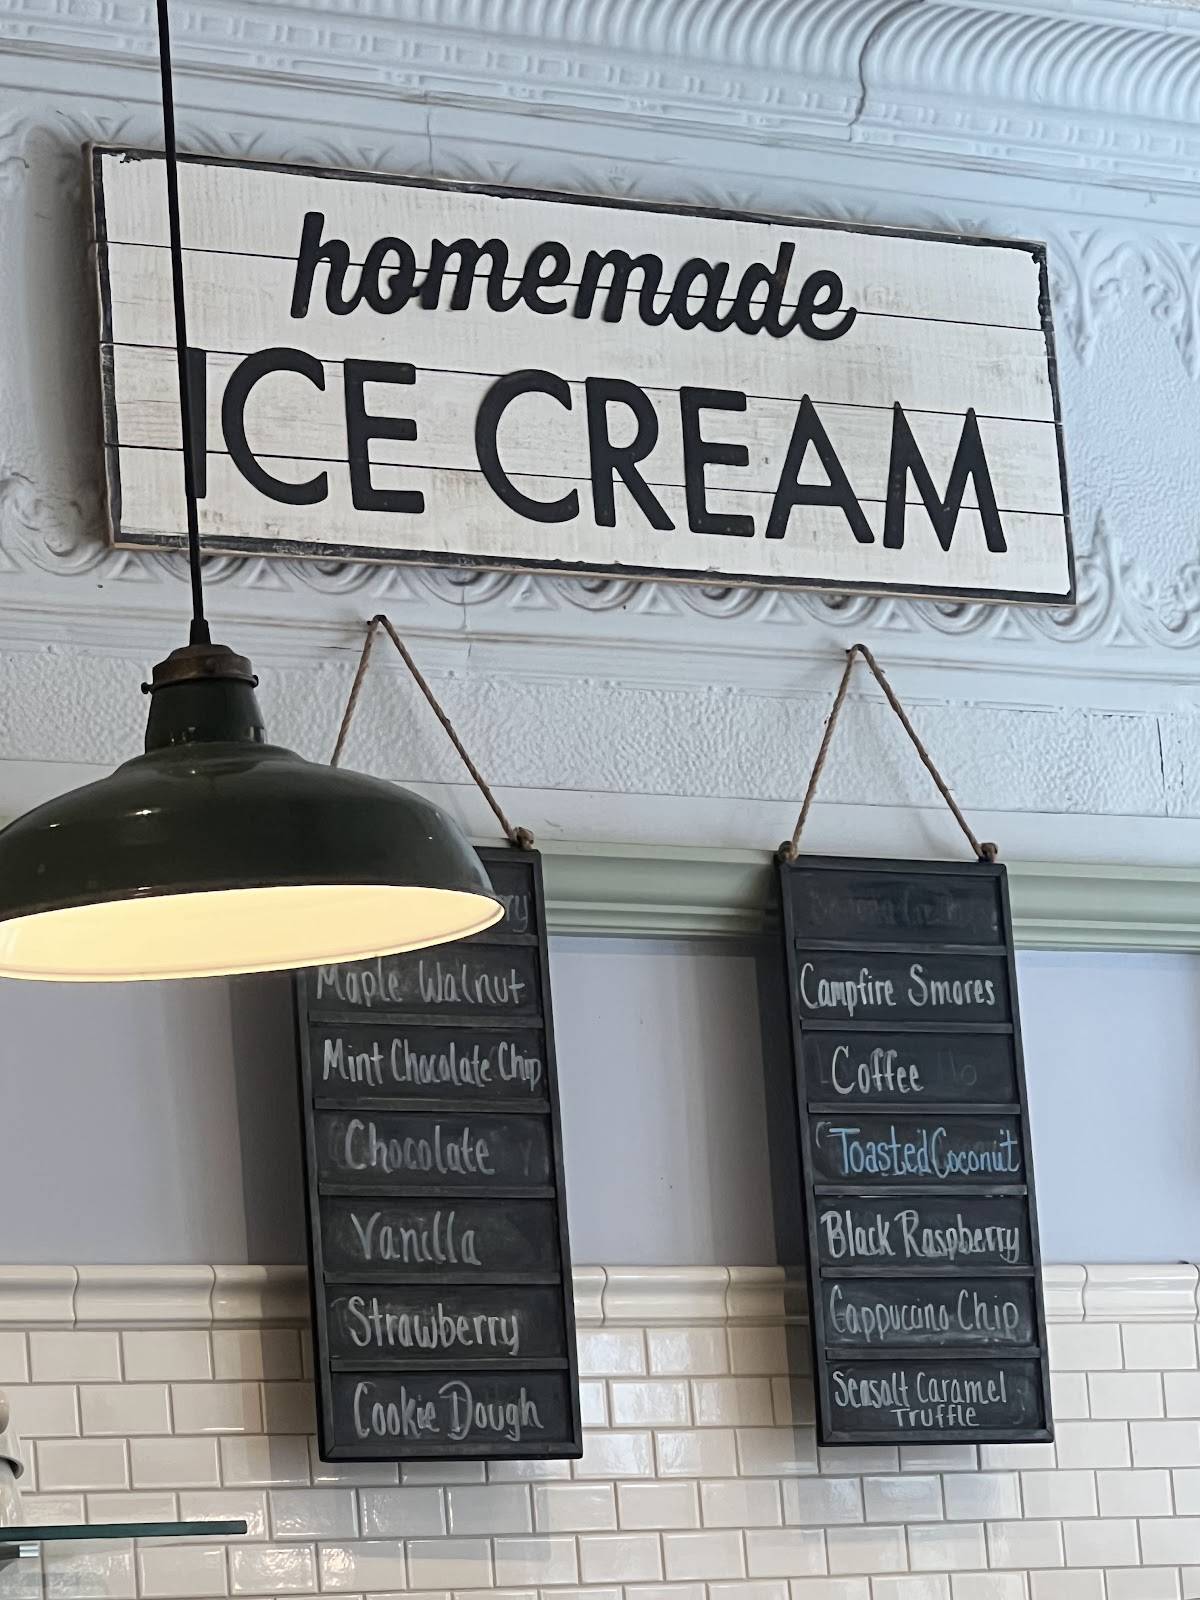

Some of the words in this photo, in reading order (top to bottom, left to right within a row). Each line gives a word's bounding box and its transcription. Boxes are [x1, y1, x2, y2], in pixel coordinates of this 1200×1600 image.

[289, 211, 857, 340] homemade
[180, 346, 425, 514] ICE
[475, 367, 1008, 554] CREAM
[317, 958, 402, 1007] Maple
[419, 960, 525, 1004] Walnut
[800, 963, 897, 1016] Campfire
[908, 963, 996, 1007] Smores
[323, 1038, 384, 1086] Mint
[391, 1038, 492, 1087] Chocolate
[499, 1041, 543, 1091] Chip
[831, 1045, 924, 1095] Coffee
[345, 1119, 496, 1174] Chocolate
[827, 1125, 931, 1177] Toasted
[931, 1126, 1020, 1178] Coconut
[350, 1210, 482, 1265] Vanilla
[820, 1210, 896, 1258] Black
[894, 1209, 1020, 1263] Raspberry
[348, 1296, 520, 1356] Strawberry
[829, 1284, 950, 1343] Cappuccino
[957, 1289, 1019, 1337] Chip
[353, 1381, 440, 1439] Cookie
[438, 1380, 544, 1442] Dough
[832, 1370, 909, 1409] Seasalt
[916, 1371, 1007, 1405] Caramel
[890, 1404, 980, 1428] Truffle
